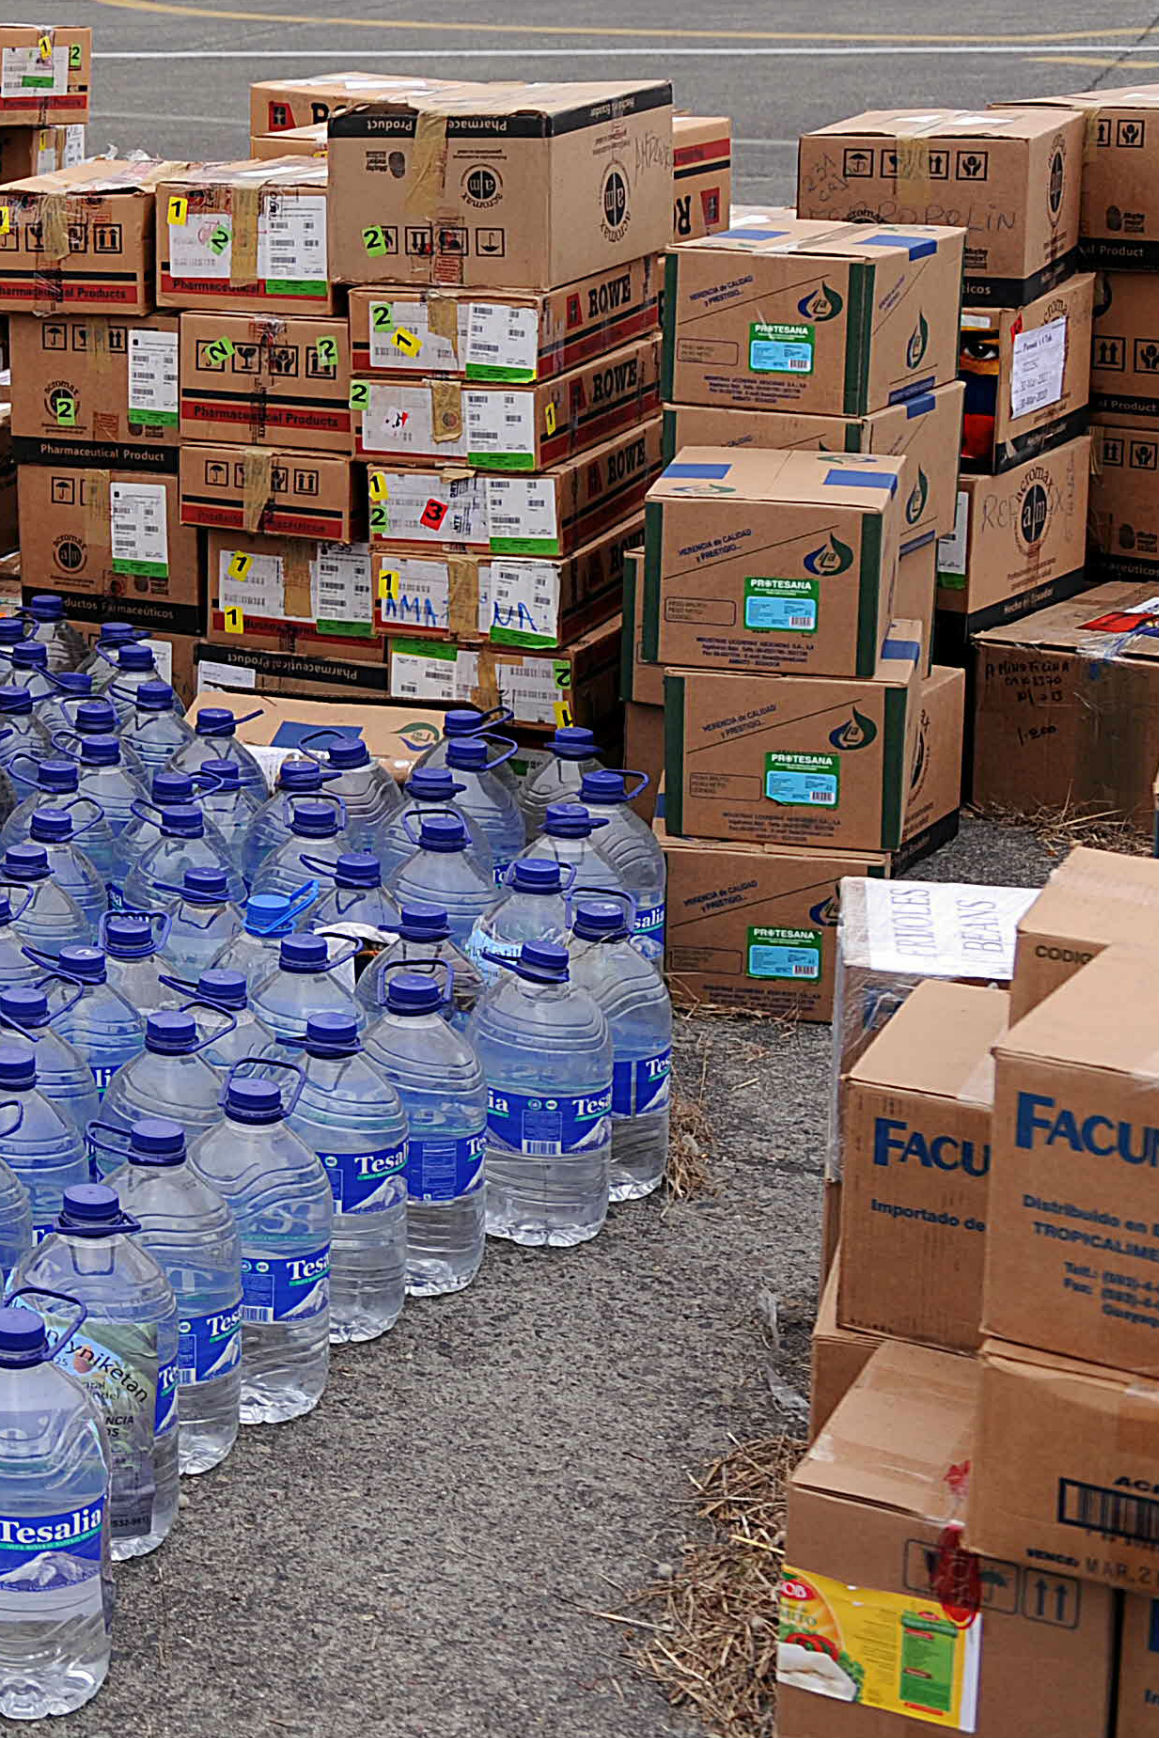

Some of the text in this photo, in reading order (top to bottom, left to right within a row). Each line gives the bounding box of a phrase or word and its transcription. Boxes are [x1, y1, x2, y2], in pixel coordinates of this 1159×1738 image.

[41, 38, 50, 53] 1
[71, 46, 81, 60] 2
[367, 120, 508, 132] Product Pharmace
[171, 200, 182, 218] 1
[211, 231, 230, 248] 2
[363, 230, 382, 250] 2
[1099, 245, 1145, 257] Product
[75, 286, 127, 300] Products
[588, 273, 632, 318] ROWE
[374, 306, 390, 326] 2
[754, 324, 809, 336] PROTESANA
[209, 342, 226, 361] 2
[318, 339, 336, 359] 2
[592, 358, 638, 402] ROWE
[351, 384, 368, 402] 2
[58, 402, 72, 419] 2
[1111, 399, 1158, 412] Product
[285, 411, 339, 428] Products
[547, 408, 554, 425] 1
[40, 443, 165, 463] Pharmaceutical Product
[607, 437, 645, 486] ROWE
[370, 476, 381, 493] 1
[370, 508, 386, 526] 2
[426, 502, 443, 521] 3
[610, 527, 645, 573] ROW
[381, 573, 393, 591] 1
[750, 578, 812, 590] PROTESANA
[226, 608, 237, 626] 1
[227, 652, 270, 668] Product
[771, 753, 833, 766] PROTESANA
[753, 928, 816, 940] PROTESANA
[870, 1198, 986, 1233] Importado de
